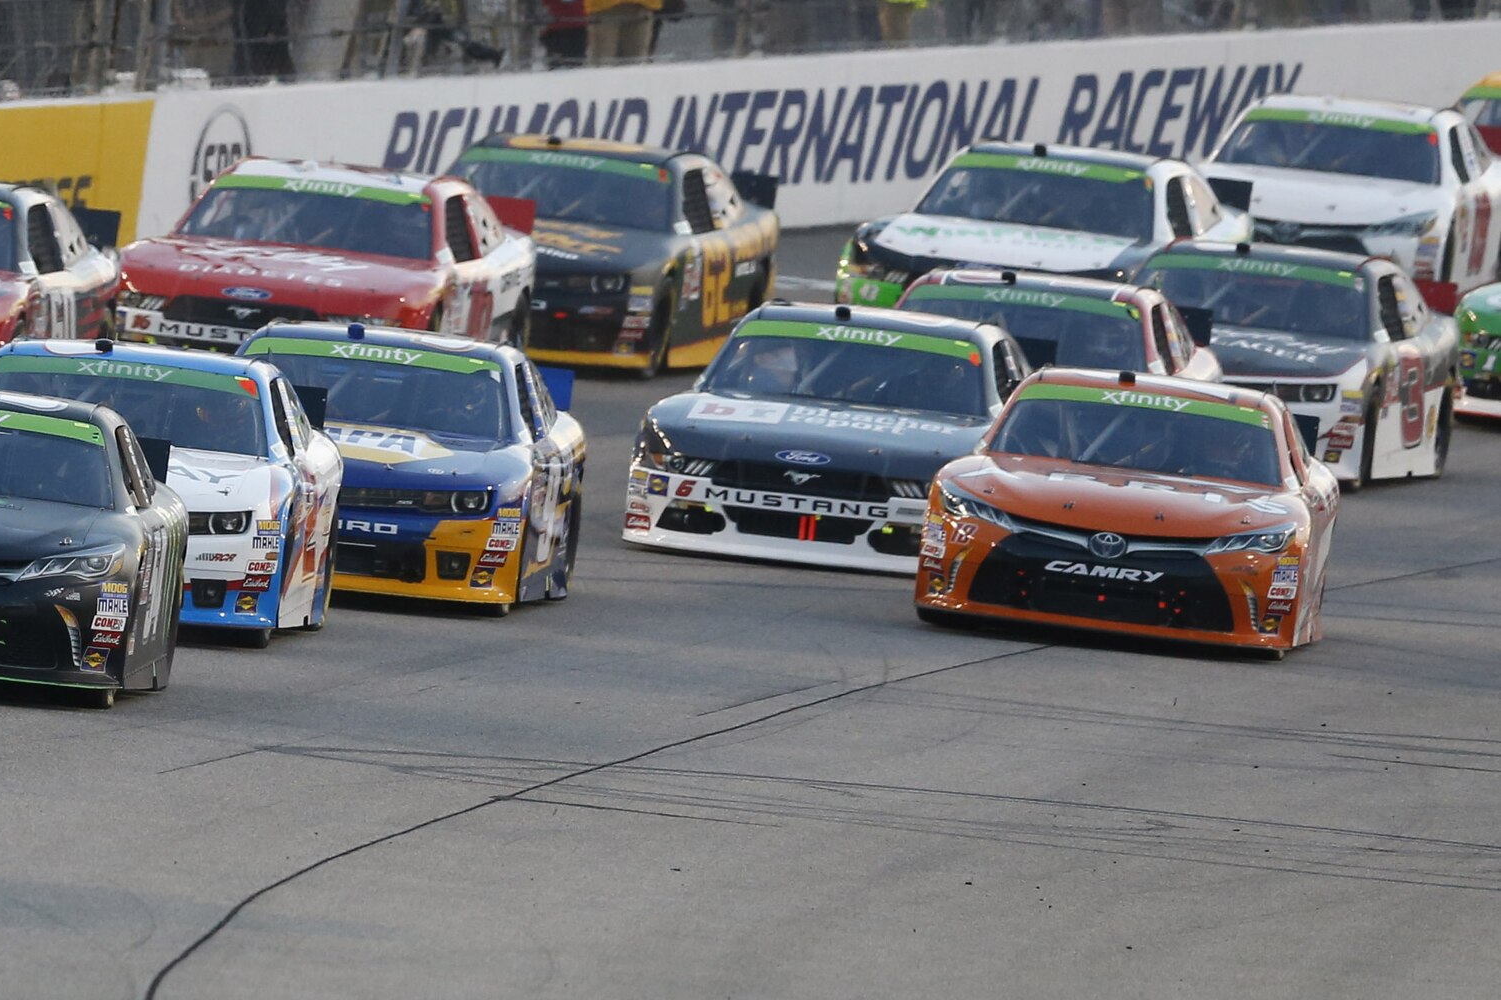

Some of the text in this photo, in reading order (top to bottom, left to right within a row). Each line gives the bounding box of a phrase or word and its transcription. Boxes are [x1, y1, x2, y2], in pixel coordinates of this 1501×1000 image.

[662, 76, 1041, 187] INTERNATIONAL
[1016, 156, 1092, 178] xfinity
[283, 177, 363, 198] xfinity
[1218, 258, 1301, 277] xfinity
[983, 288, 1067, 308] xfinity
[816, 324, 903, 347] xfinity
[330, 342, 424, 365] xfinity
[76, 359, 175, 382] xfinity
[1100, 389, 1191, 412] xfinity
[787, 413, 910, 436] report
[790, 404, 958, 436] bleacher
[784, 449, 823, 465] Ford
[675, 479, 697, 497] 6
[705, 486, 890, 518] MUSTANG
[257, 520, 281, 531] MOOG
[253, 536, 280, 550] MAHLE
[1043, 559, 1165, 584] CAMRY
[101, 582, 129, 594] MOOG
[98, 599, 128, 613] MAHLE
